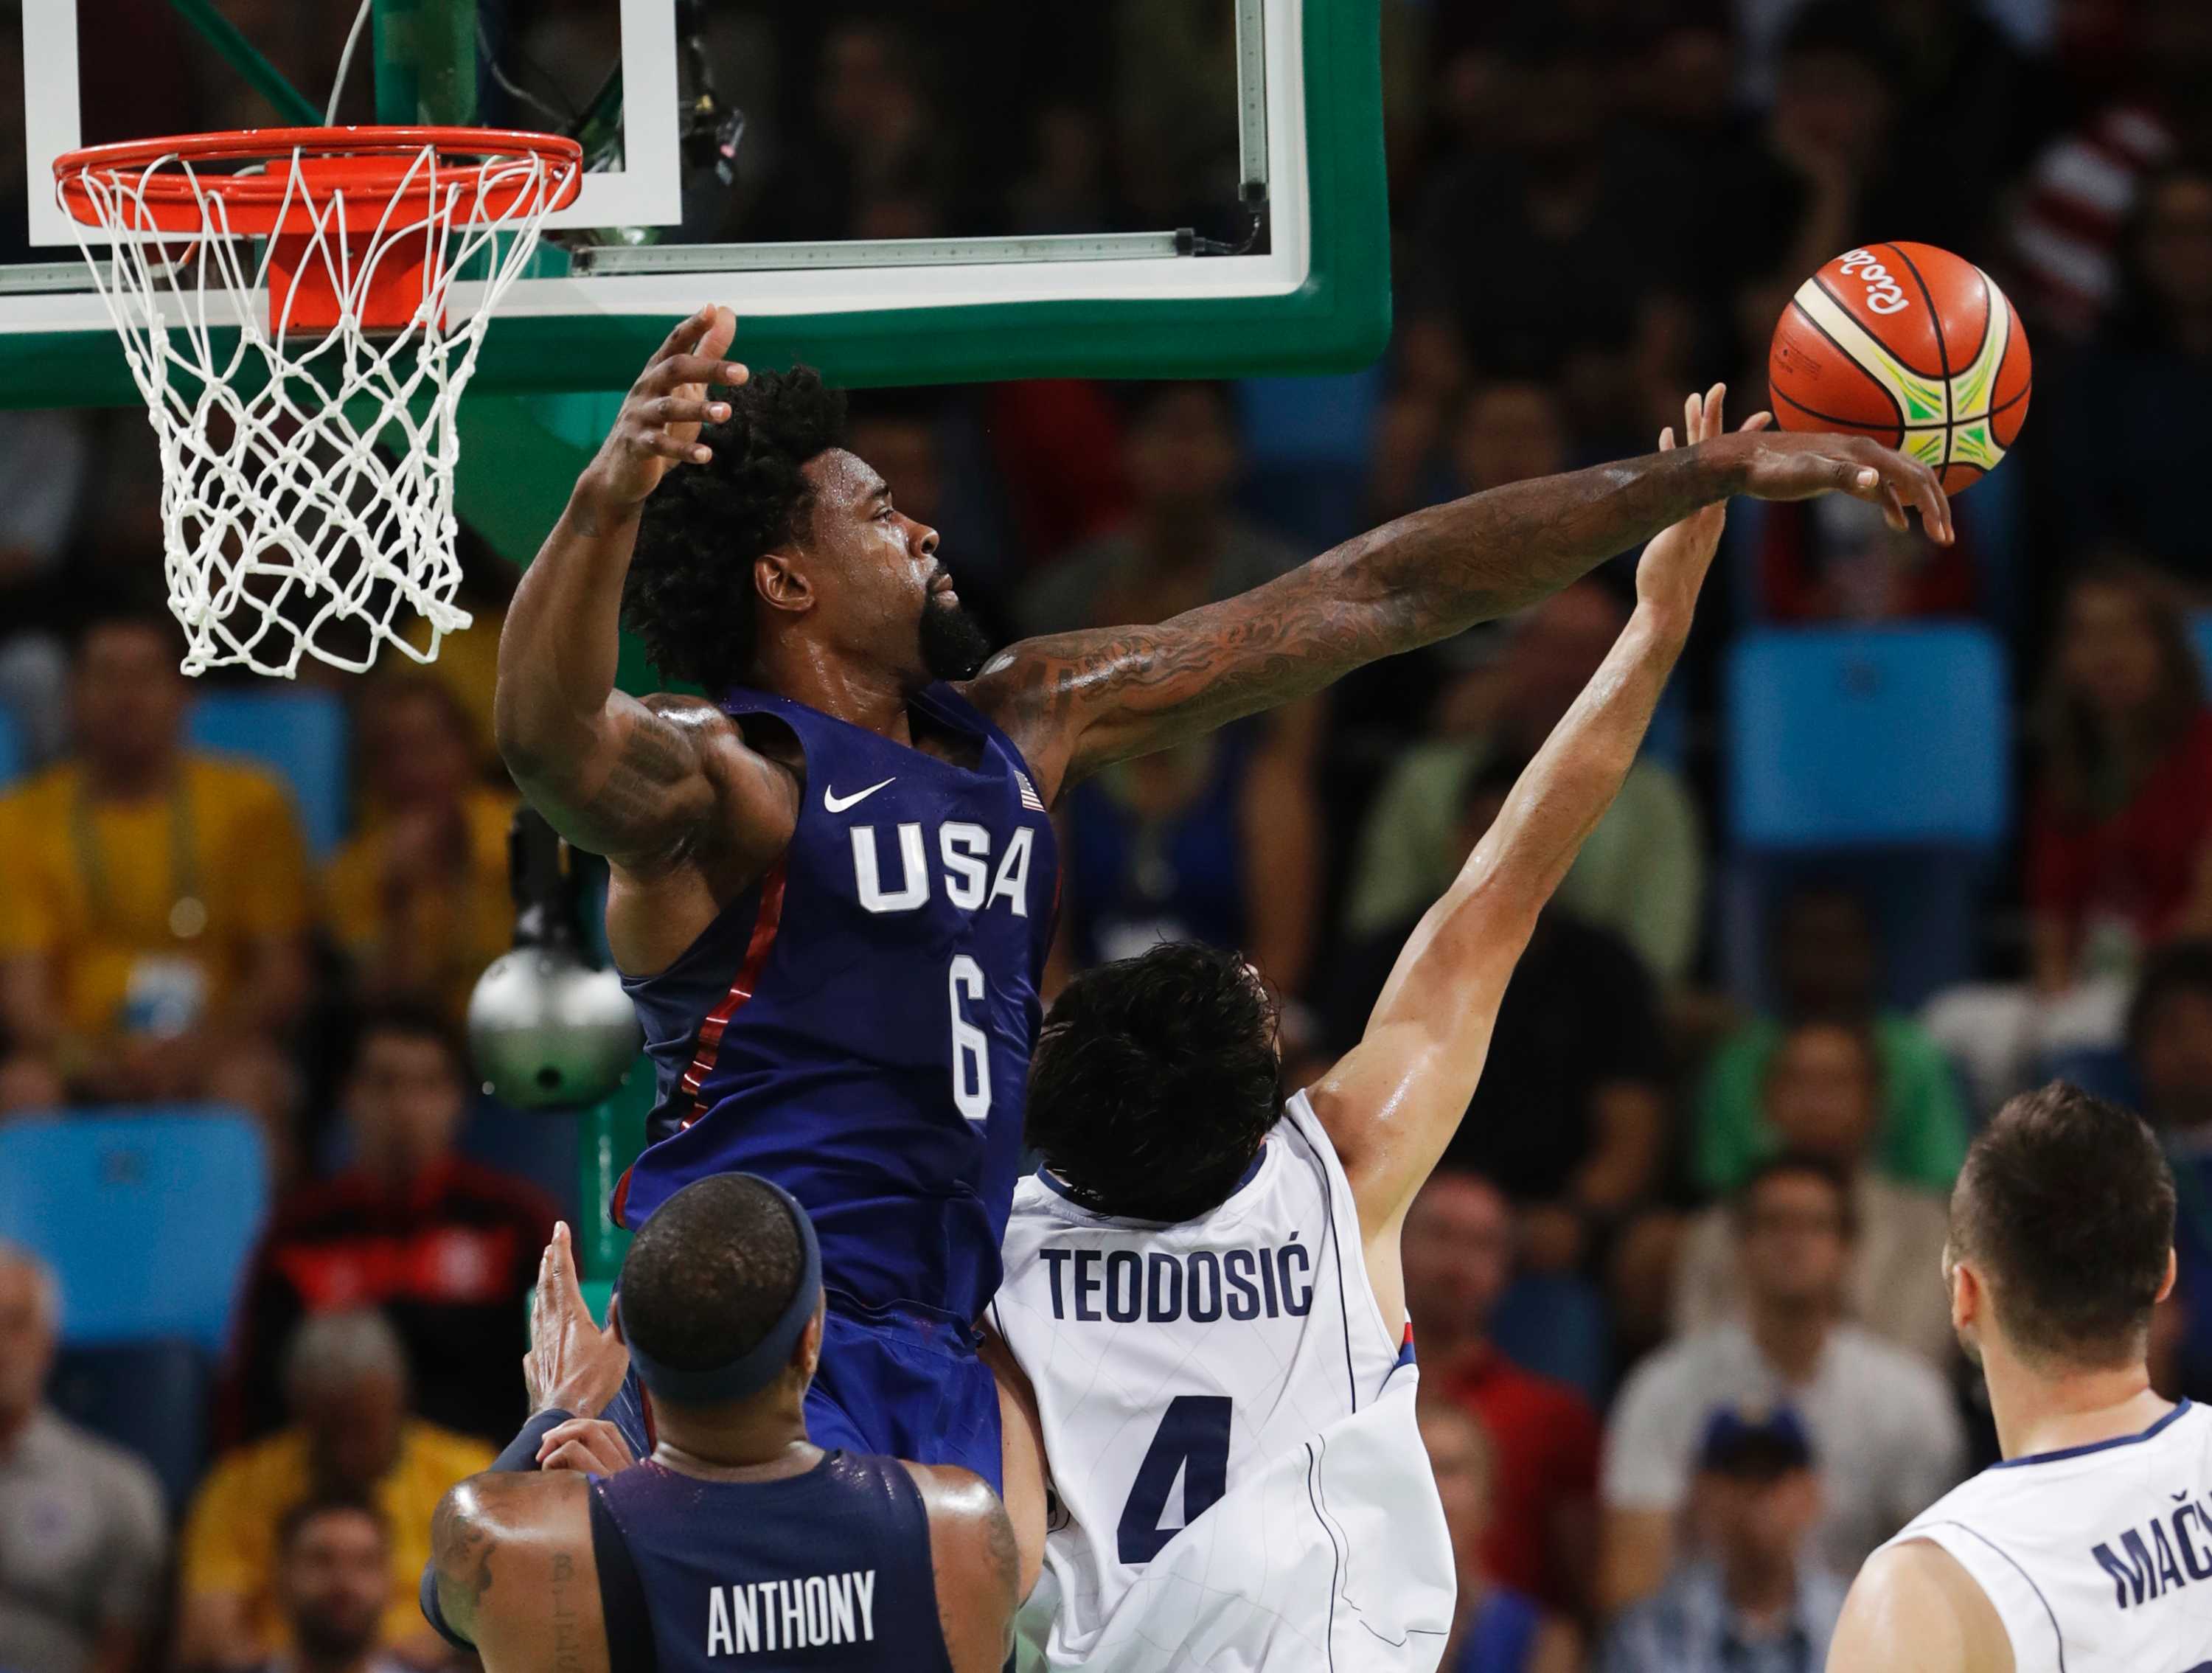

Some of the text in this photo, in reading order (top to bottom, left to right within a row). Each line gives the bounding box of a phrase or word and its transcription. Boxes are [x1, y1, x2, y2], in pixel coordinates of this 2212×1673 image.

[1839, 249, 1909, 314] Rio20
[849, 820, 1034, 918] USA
[949, 954, 992, 1120] 6
[1040, 1231, 1312, 1323] TEODOSIĆ
[1117, 1396, 1232, 1564] 4
[708, 1570, 875, 1657] ANTHONY
